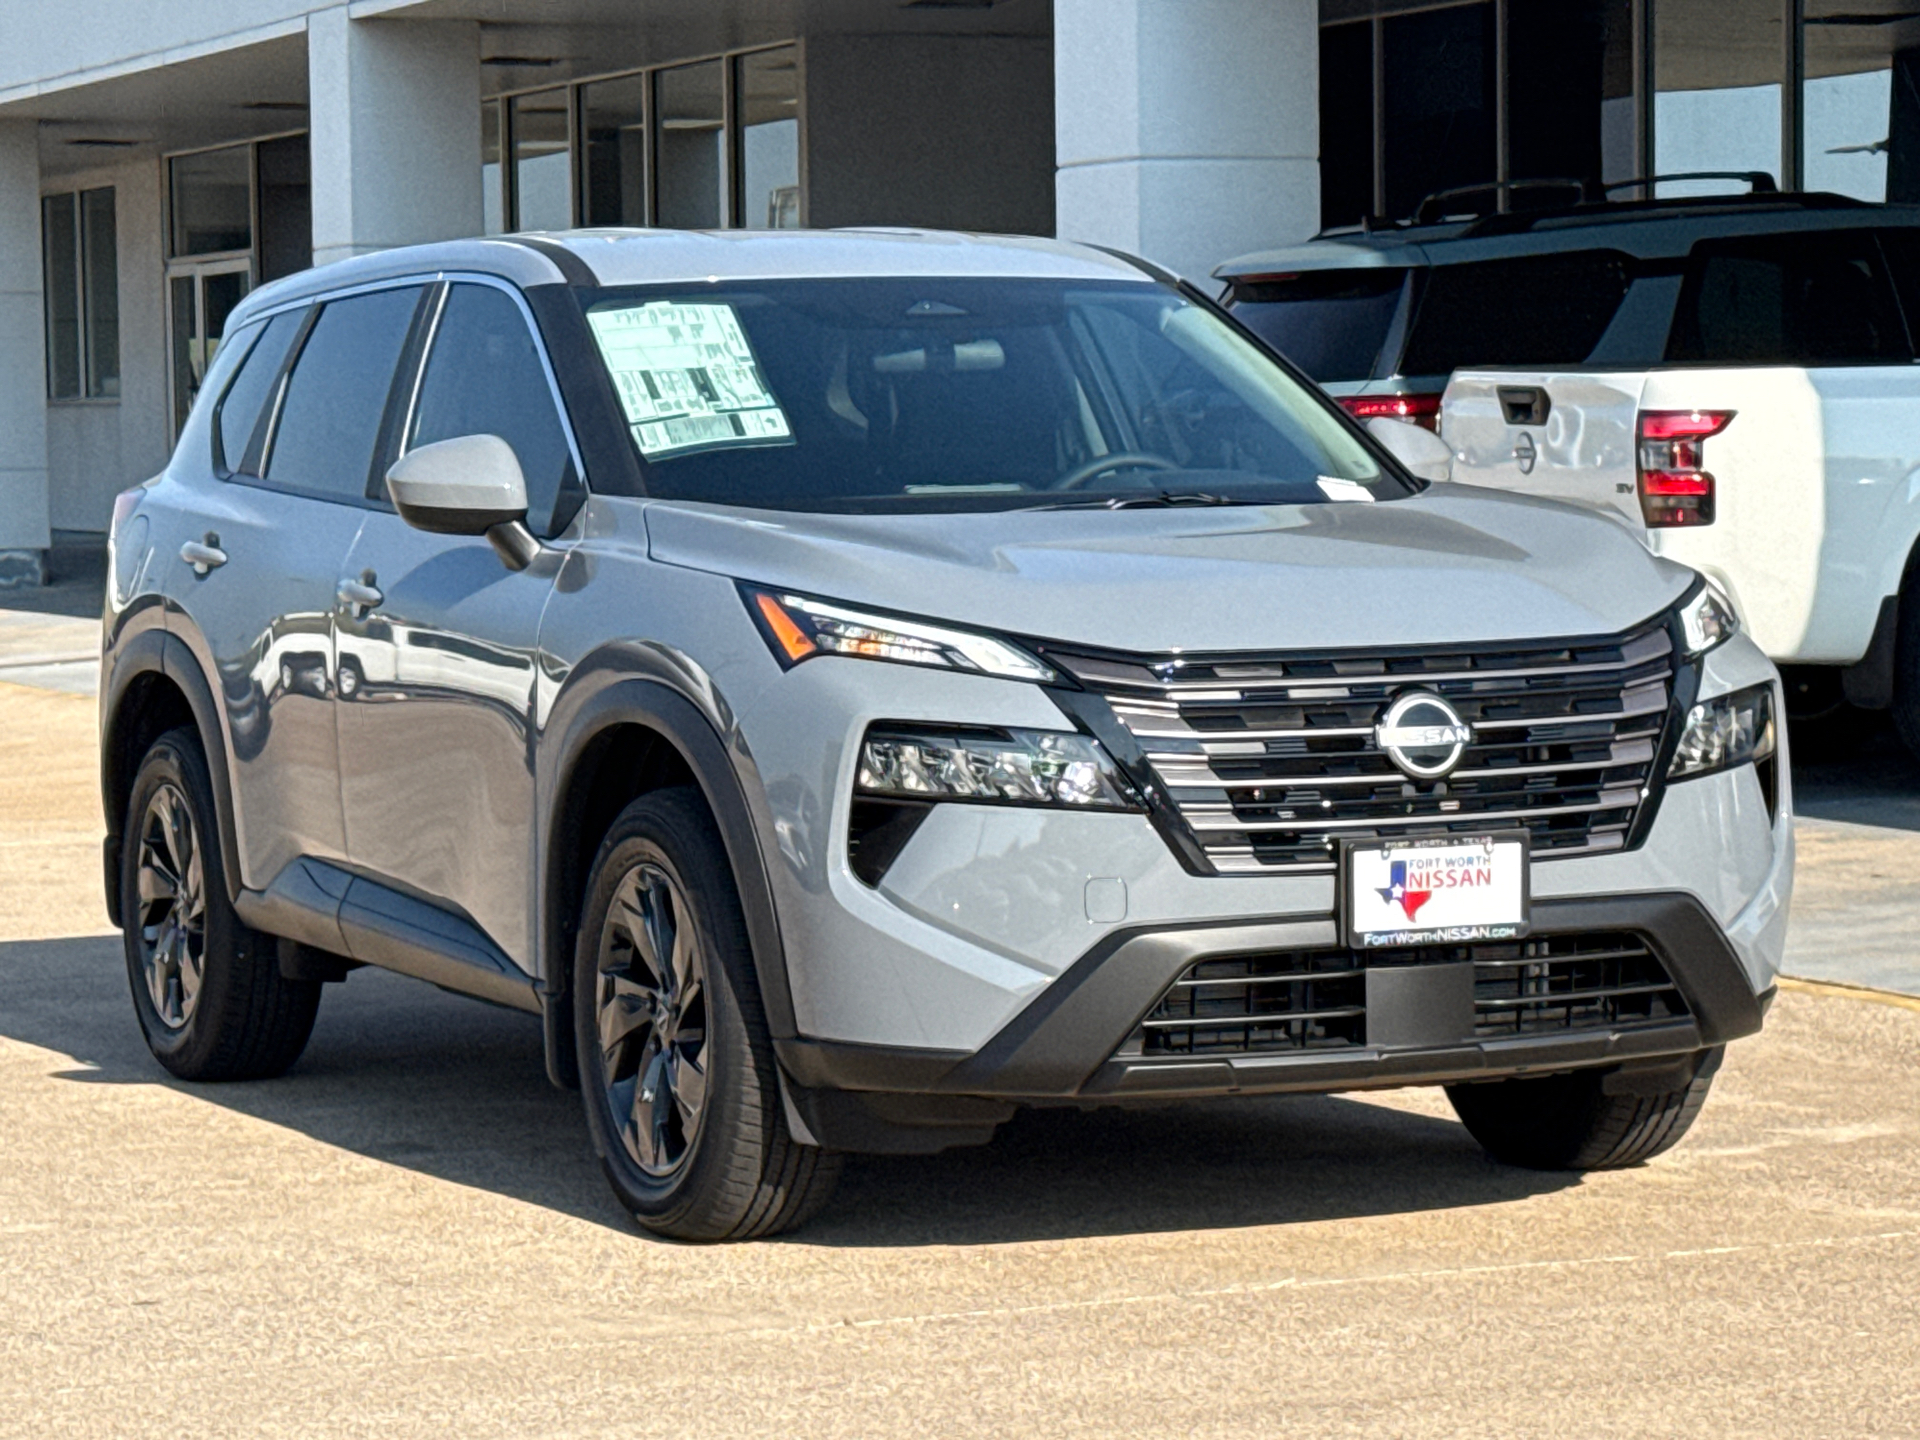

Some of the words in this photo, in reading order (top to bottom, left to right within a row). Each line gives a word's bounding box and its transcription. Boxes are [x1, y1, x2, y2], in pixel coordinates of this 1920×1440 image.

[1381, 727, 1471, 745] SSAN
[1409, 857, 1441, 869] FORT
[1444, 855, 1491, 867] WORTH
[1409, 868, 1491, 889] NISSAN
